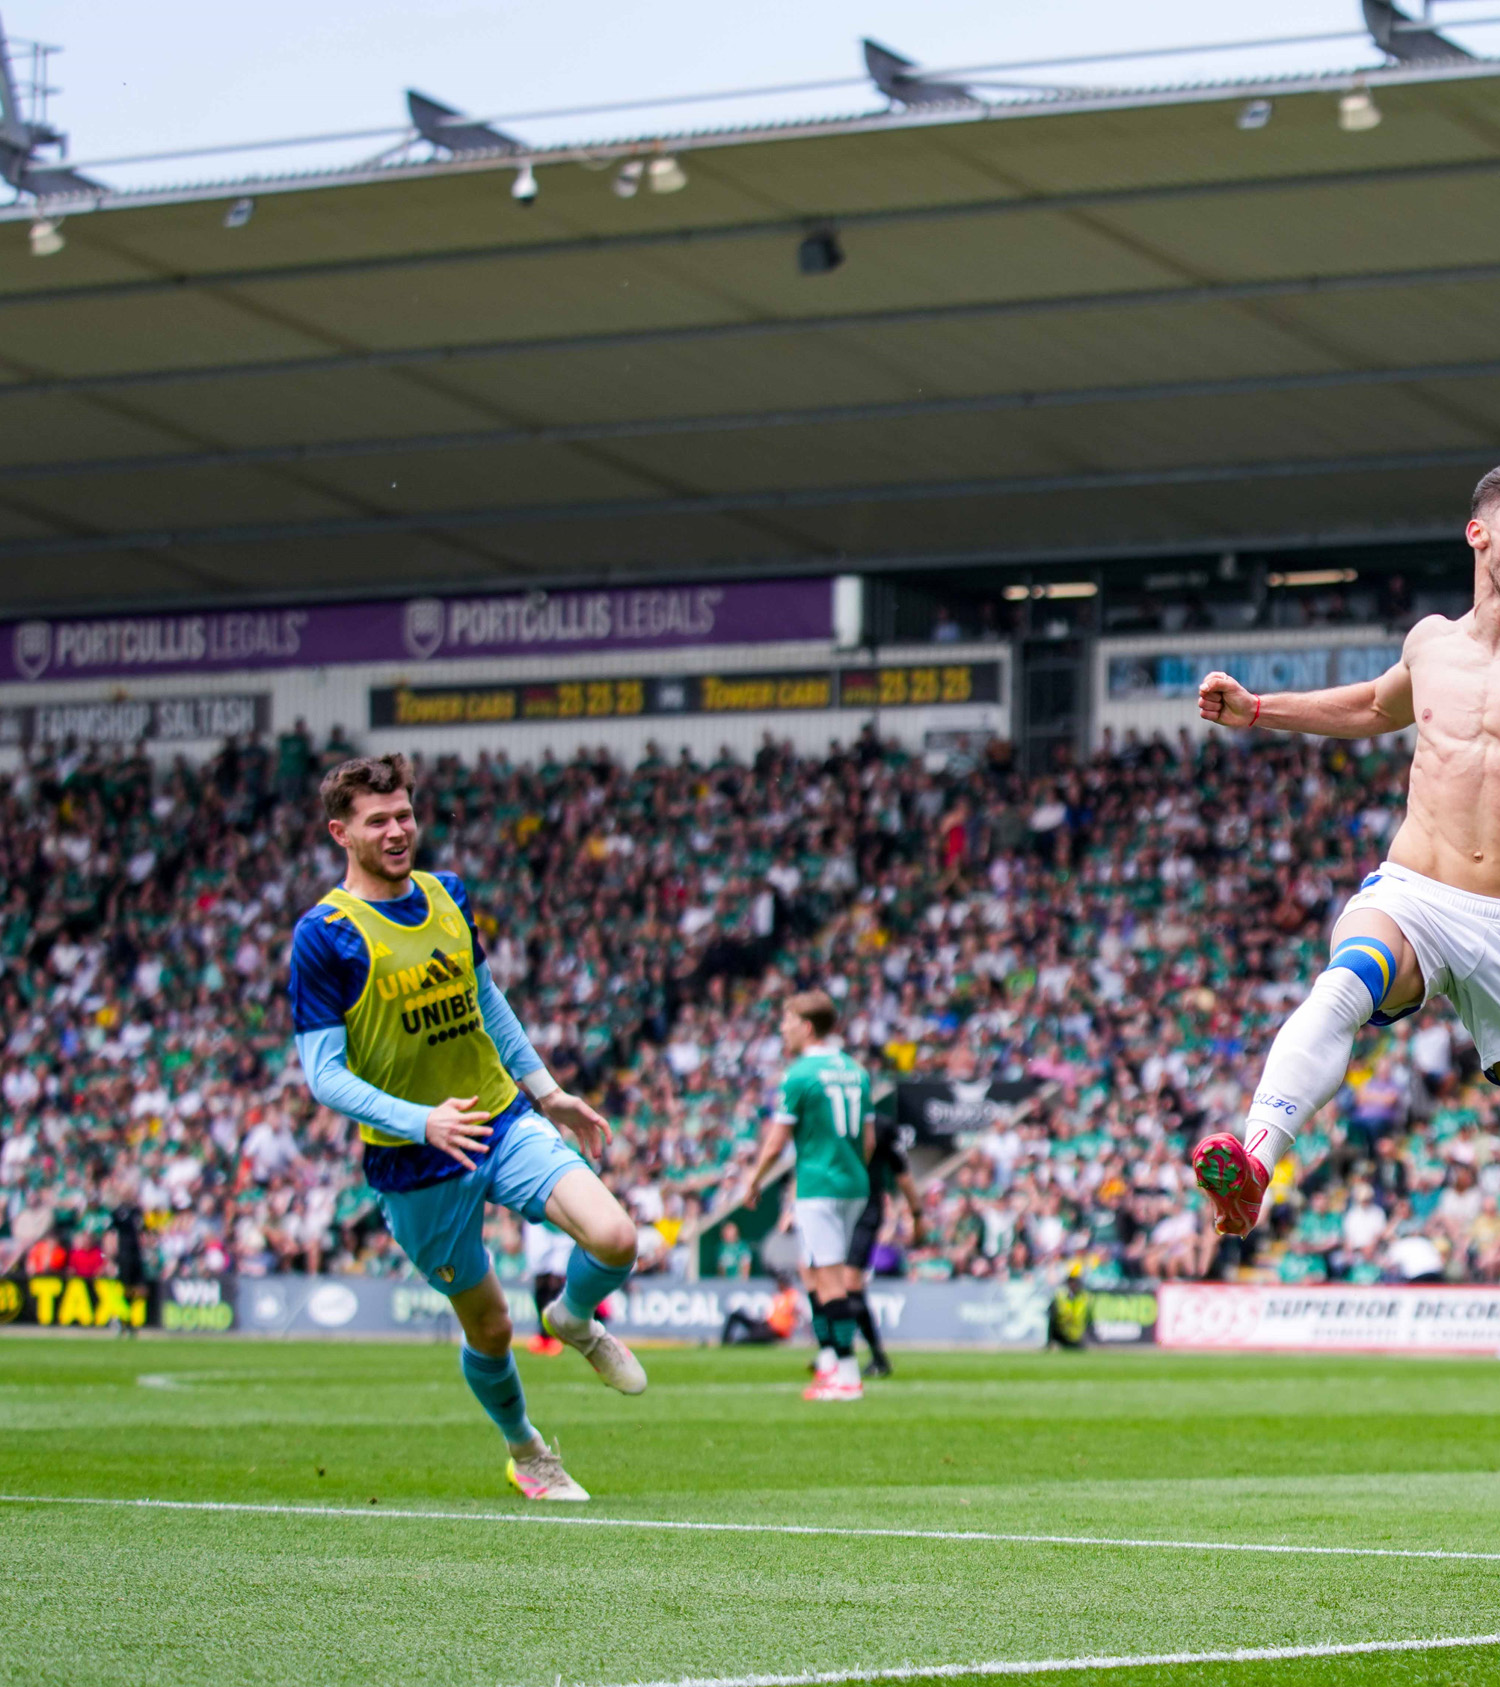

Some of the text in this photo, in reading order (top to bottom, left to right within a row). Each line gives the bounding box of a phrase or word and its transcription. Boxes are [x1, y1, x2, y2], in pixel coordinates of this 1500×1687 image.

[55, 616, 207, 668] PORTCULLIS
[449, 594, 614, 646] PORTCULLIS
[401, 987, 477, 1034] UNIBE
[631, 1288, 725, 1328] LOCAL
[1266, 1299, 1400, 1320] SUPERIOR
